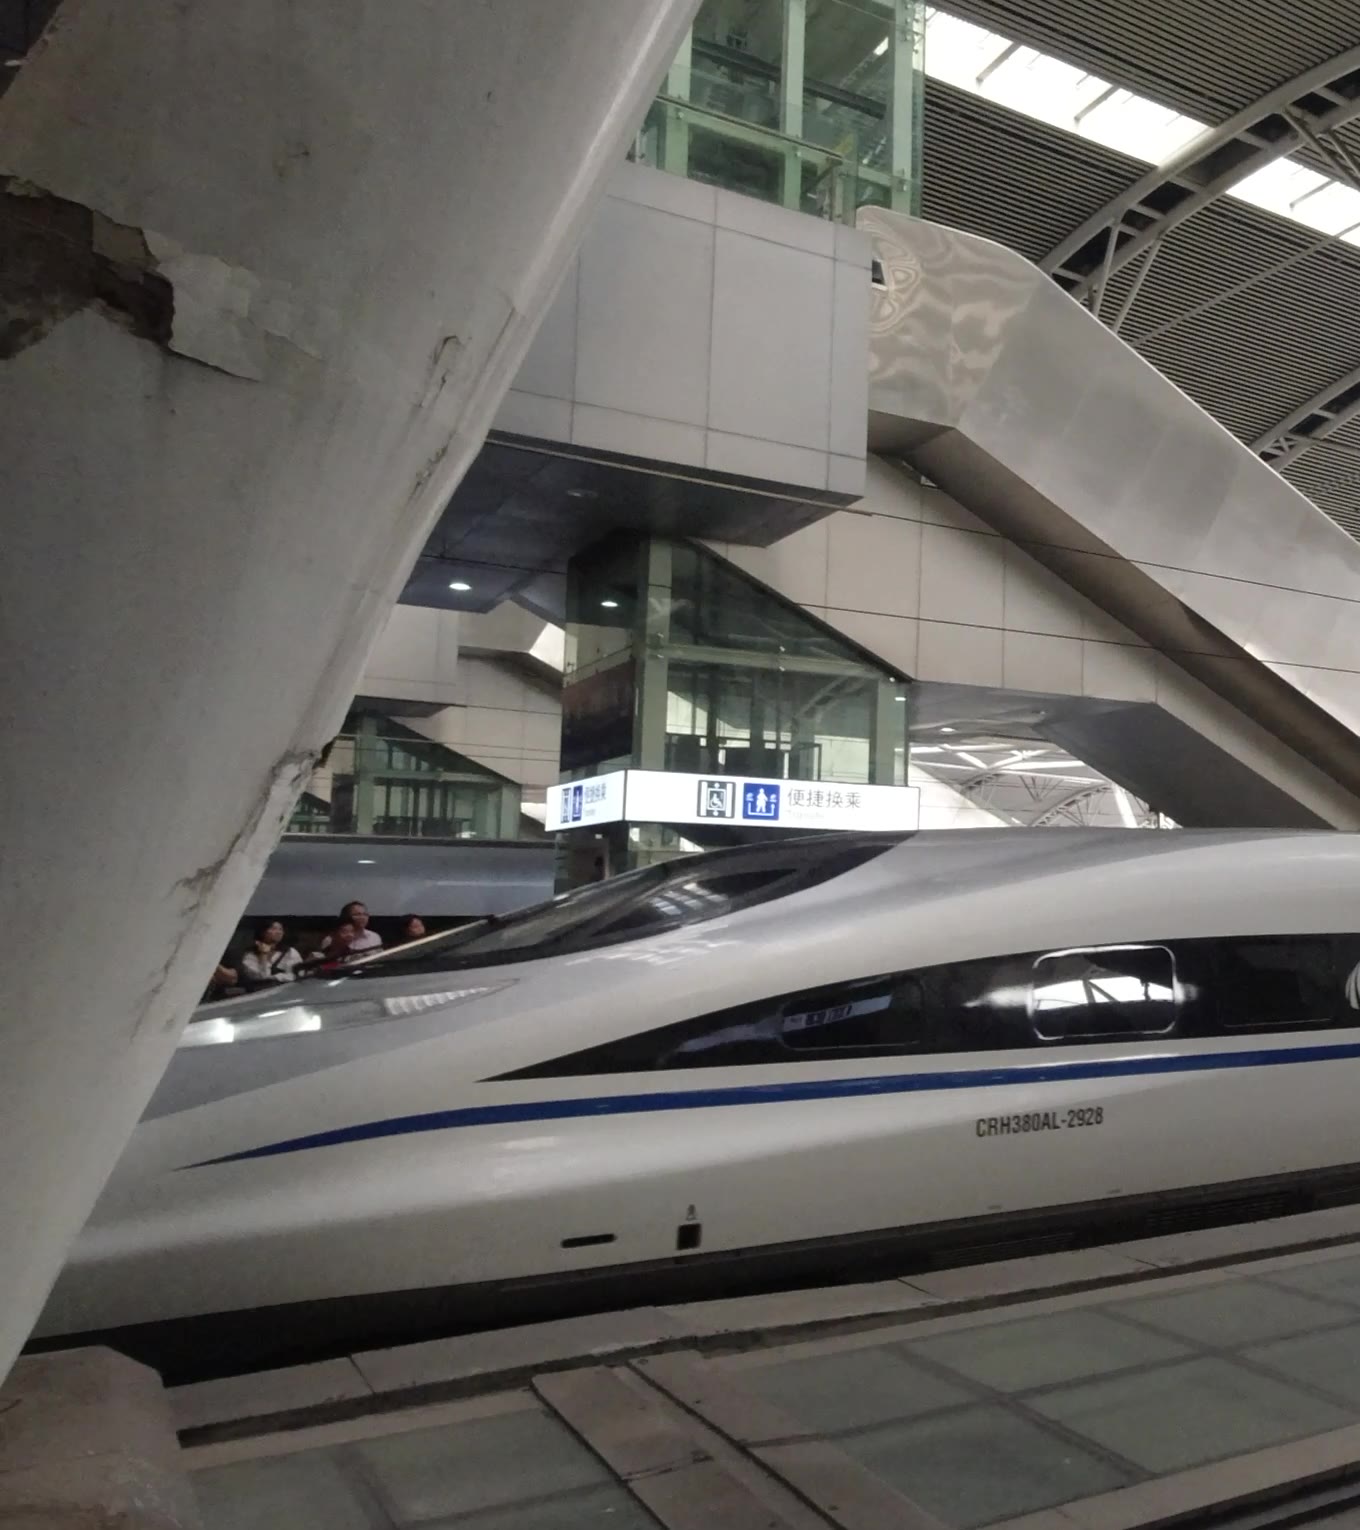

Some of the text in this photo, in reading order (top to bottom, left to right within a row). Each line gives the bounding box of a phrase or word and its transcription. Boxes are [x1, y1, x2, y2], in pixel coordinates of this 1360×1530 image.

[787, 788, 862, 809] 便捷换乘
[975, 1106, 1104, 1138] CRH380AL-2928
